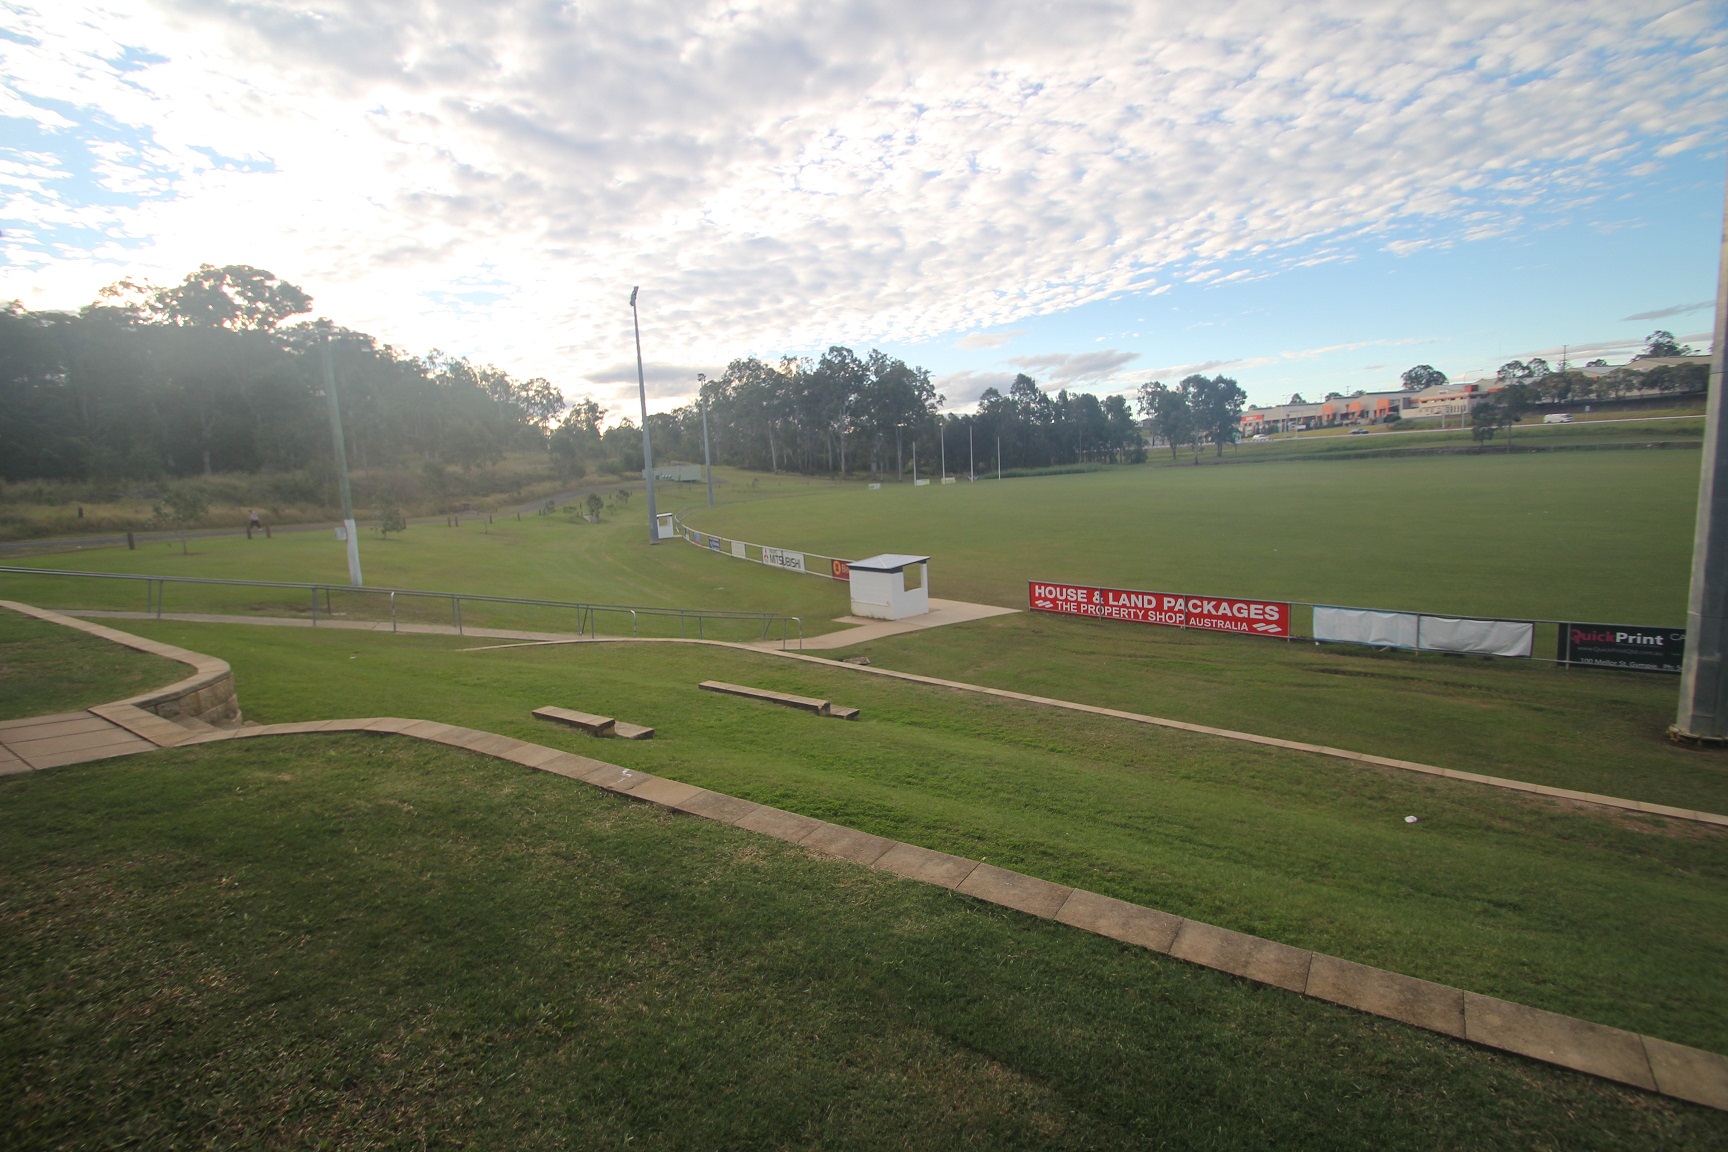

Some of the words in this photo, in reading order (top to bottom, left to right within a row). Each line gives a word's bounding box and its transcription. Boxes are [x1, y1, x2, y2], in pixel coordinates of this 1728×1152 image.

[1035, 585, 1087, 602] HOUSE
[1092, 591, 1104, 604] &
[1108, 592, 1157, 608] LAND
[1163, 597, 1279, 620] PACKAGES
[1056, 601, 1077, 612] THE
[1081, 603, 1144, 619] PROPERTY
[1148, 610, 1184, 623] SHOP
[1189, 617, 1248, 631] AUSTRALIA
[1571, 629, 1664, 645] QuickPrint
